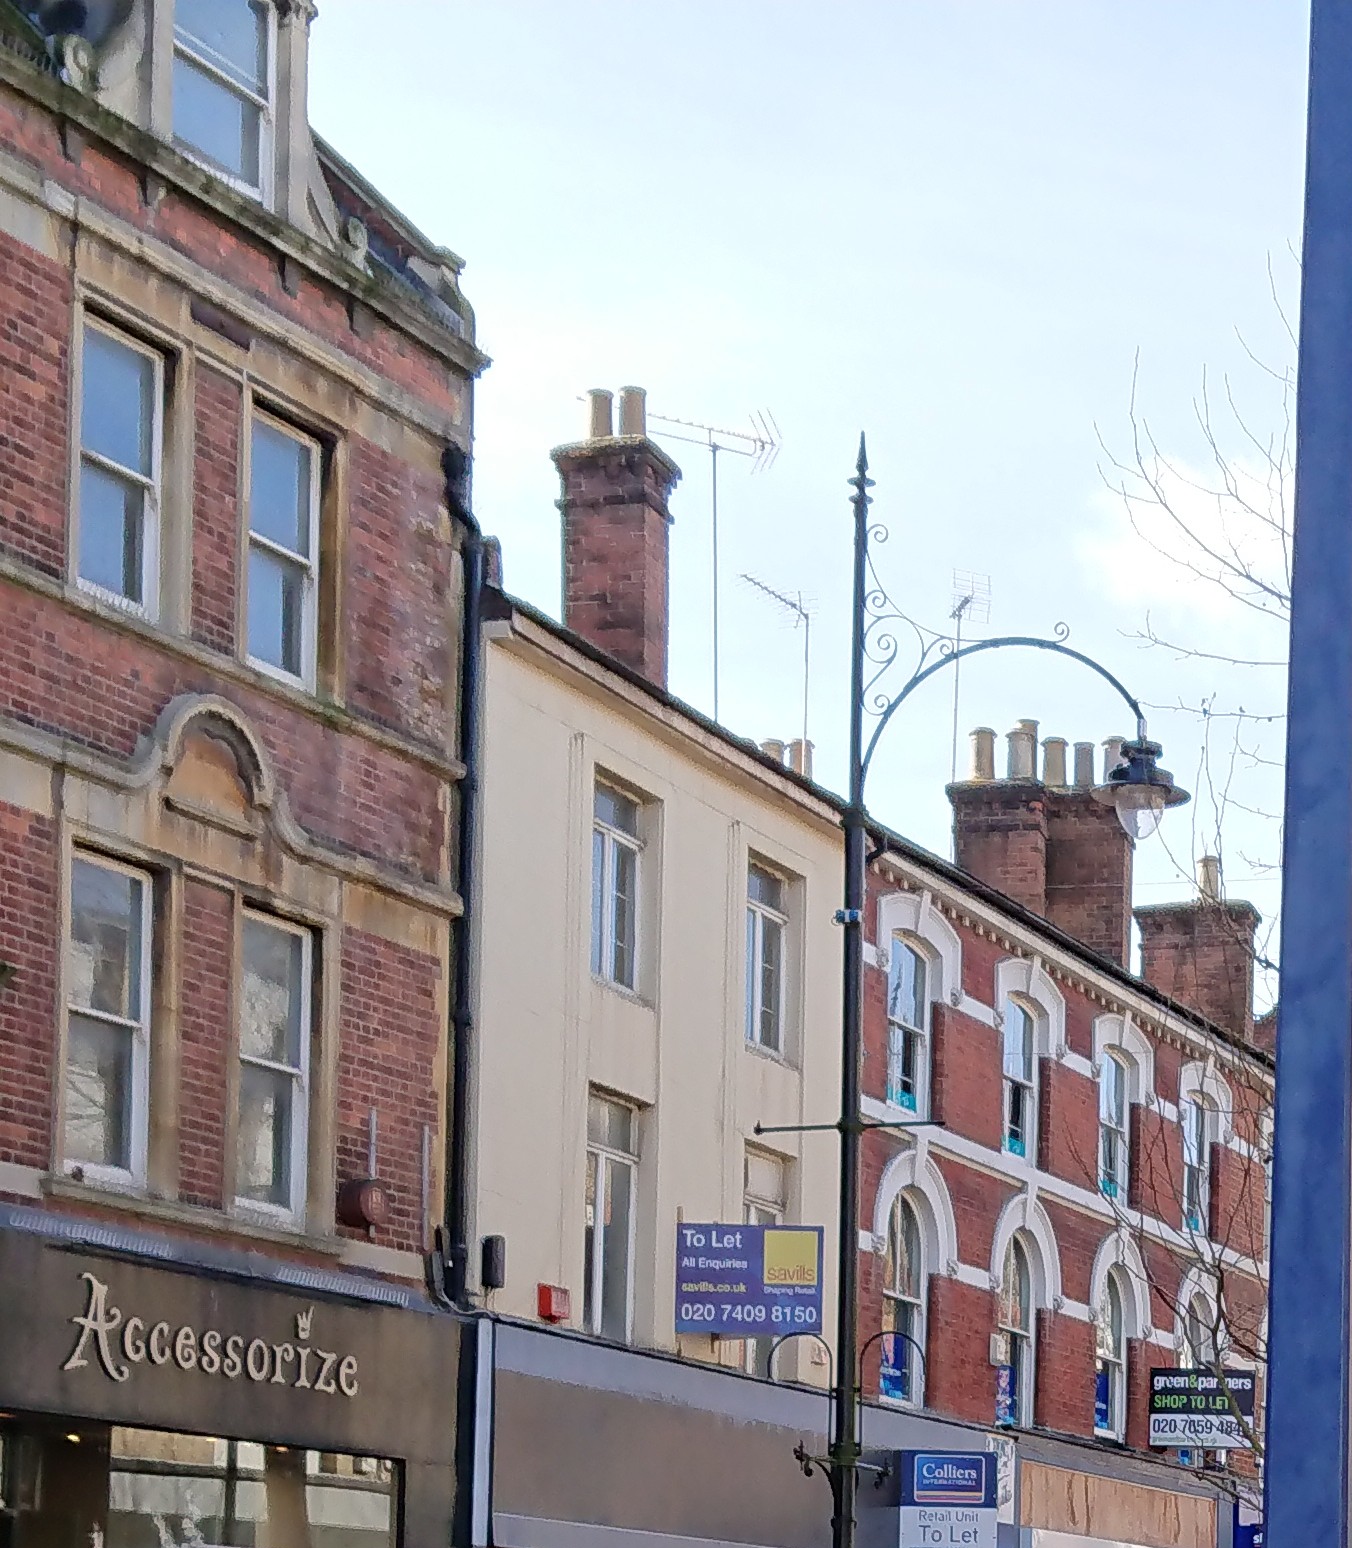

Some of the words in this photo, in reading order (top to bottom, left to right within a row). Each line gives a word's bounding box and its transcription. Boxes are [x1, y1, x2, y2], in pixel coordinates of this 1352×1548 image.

[683, 1230, 705, 1248] To
[712, 1230, 742, 1248] Let
[682, 1257, 695, 1267] All
[699, 1257, 748, 1270] Enquiries
[767, 1265, 815, 1282] savills
[681, 1282, 746, 1293] savills.co.uk
[681, 1303, 715, 1321] 020
[721, 1304, 766, 1322] 7409
[771, 1305, 817, 1323] 8150
[62, 1272, 359, 1397] Accessorize
[1153, 1374, 1252, 1391] green&parners
[1154, 1395, 1188, 1409] SHOP
[1190, 1395, 1206, 1409] TO
[1152, 1418, 1177, 1434] 020
[922, 1463, 978, 1479] Colliers
[918, 1509, 952, 1522] Retail
[955, 1511, 979, 1523] Unit
[918, 1524, 943, 1543] To
[949, 1525, 979, 1544] Let
